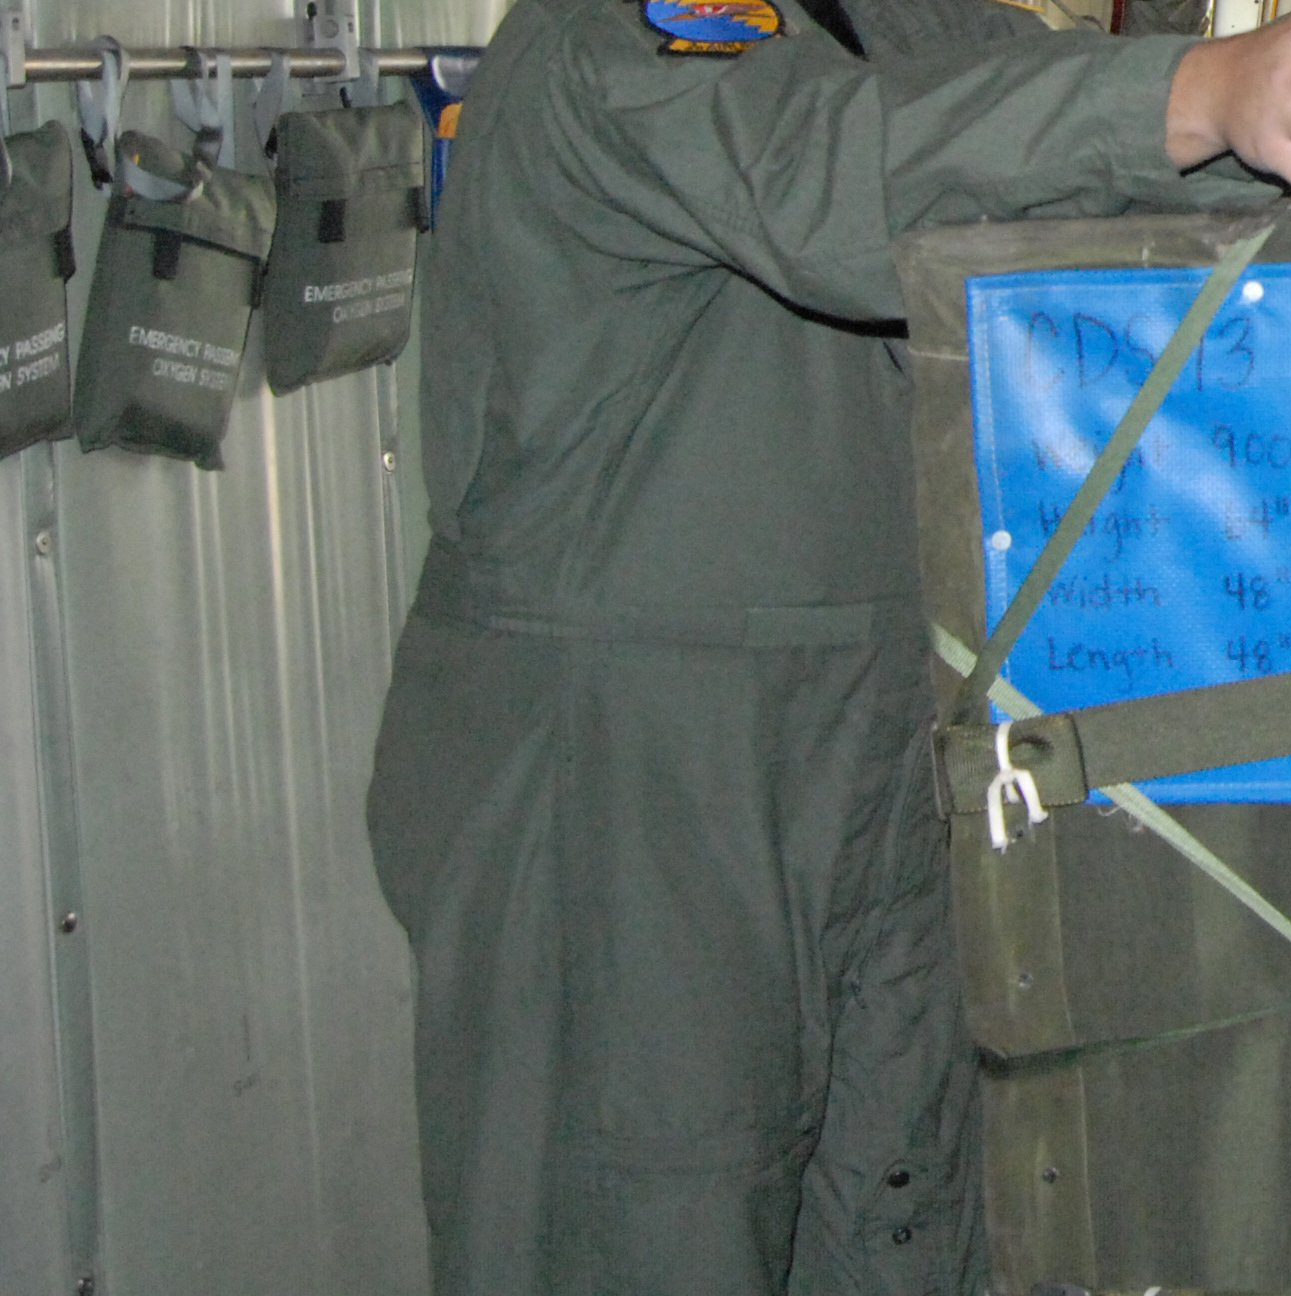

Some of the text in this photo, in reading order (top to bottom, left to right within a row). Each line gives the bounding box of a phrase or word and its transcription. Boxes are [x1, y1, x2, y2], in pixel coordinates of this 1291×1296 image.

[128, 325, 202, 358] EMERGENCY
[1037, 500, 1172, 563] Hight
[1046, 572, 1162, 614] Width
[1047, 635, 1175, 694] Length
